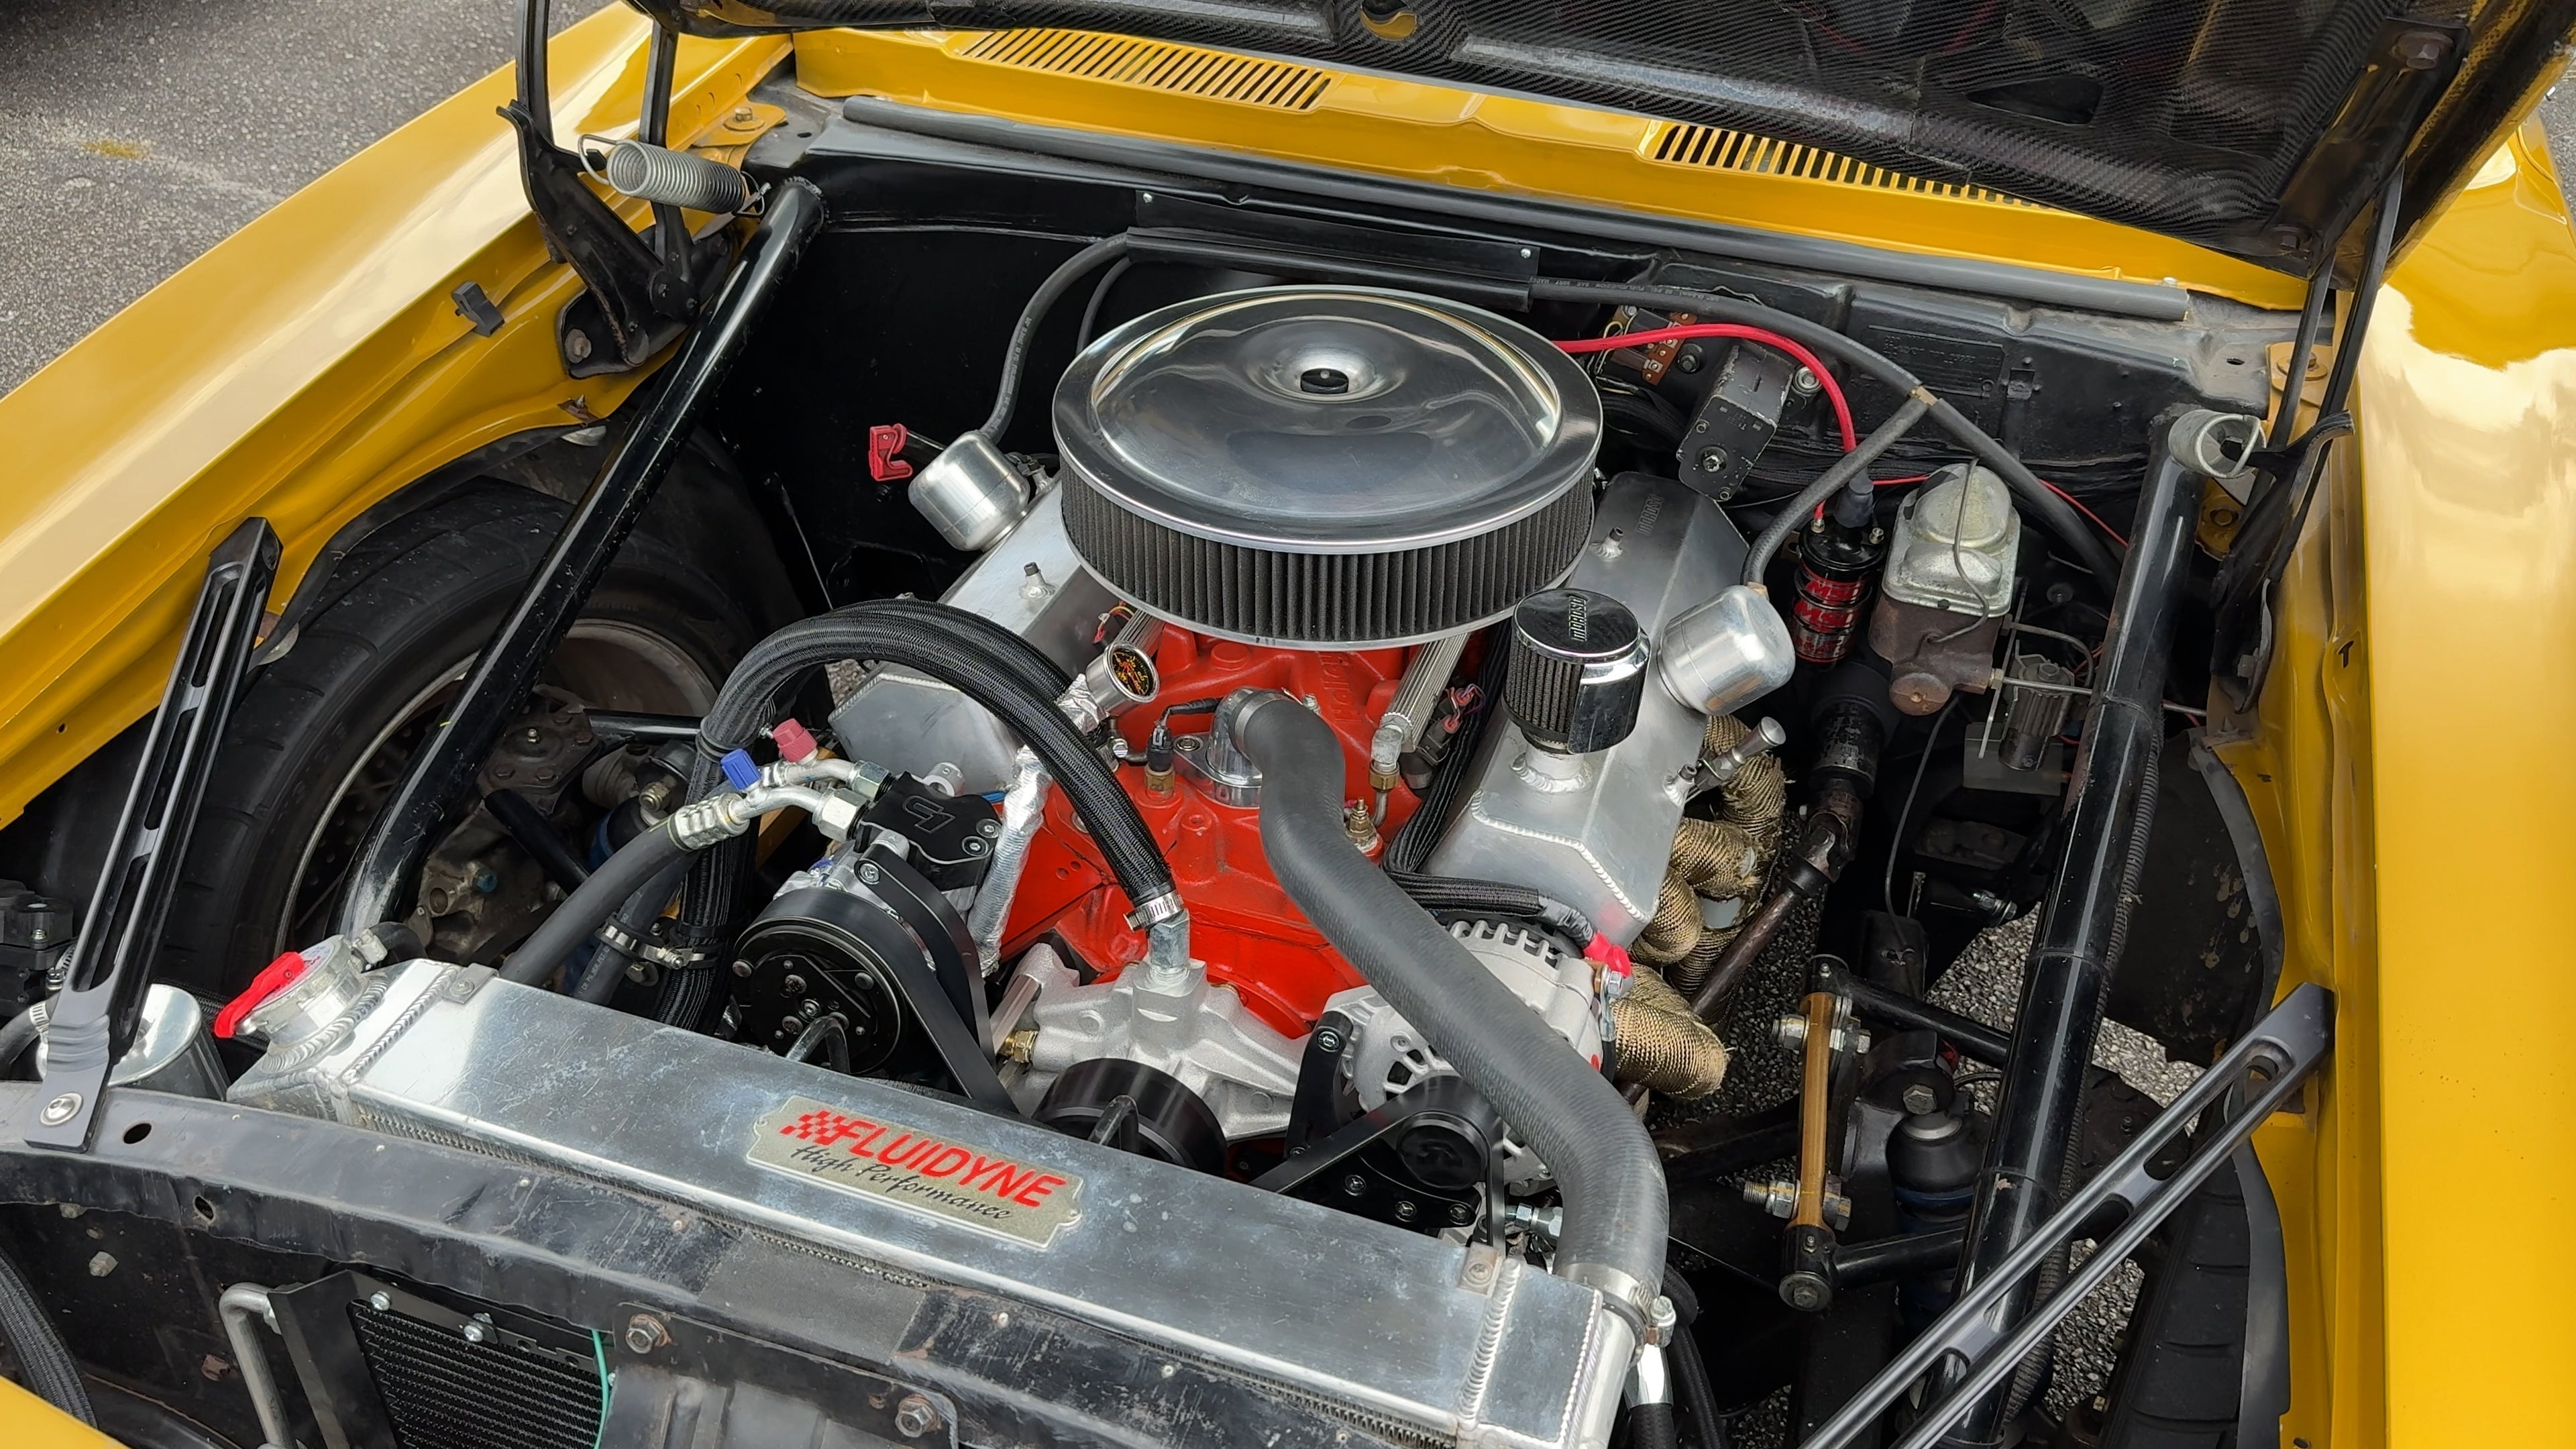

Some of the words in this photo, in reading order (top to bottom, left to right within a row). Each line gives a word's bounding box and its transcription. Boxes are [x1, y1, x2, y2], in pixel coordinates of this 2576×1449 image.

[791, 1144, 854, 1173] High
[858, 1161, 1012, 1220] Performance
[839, 1119, 1066, 1208] FLUIDYNE
